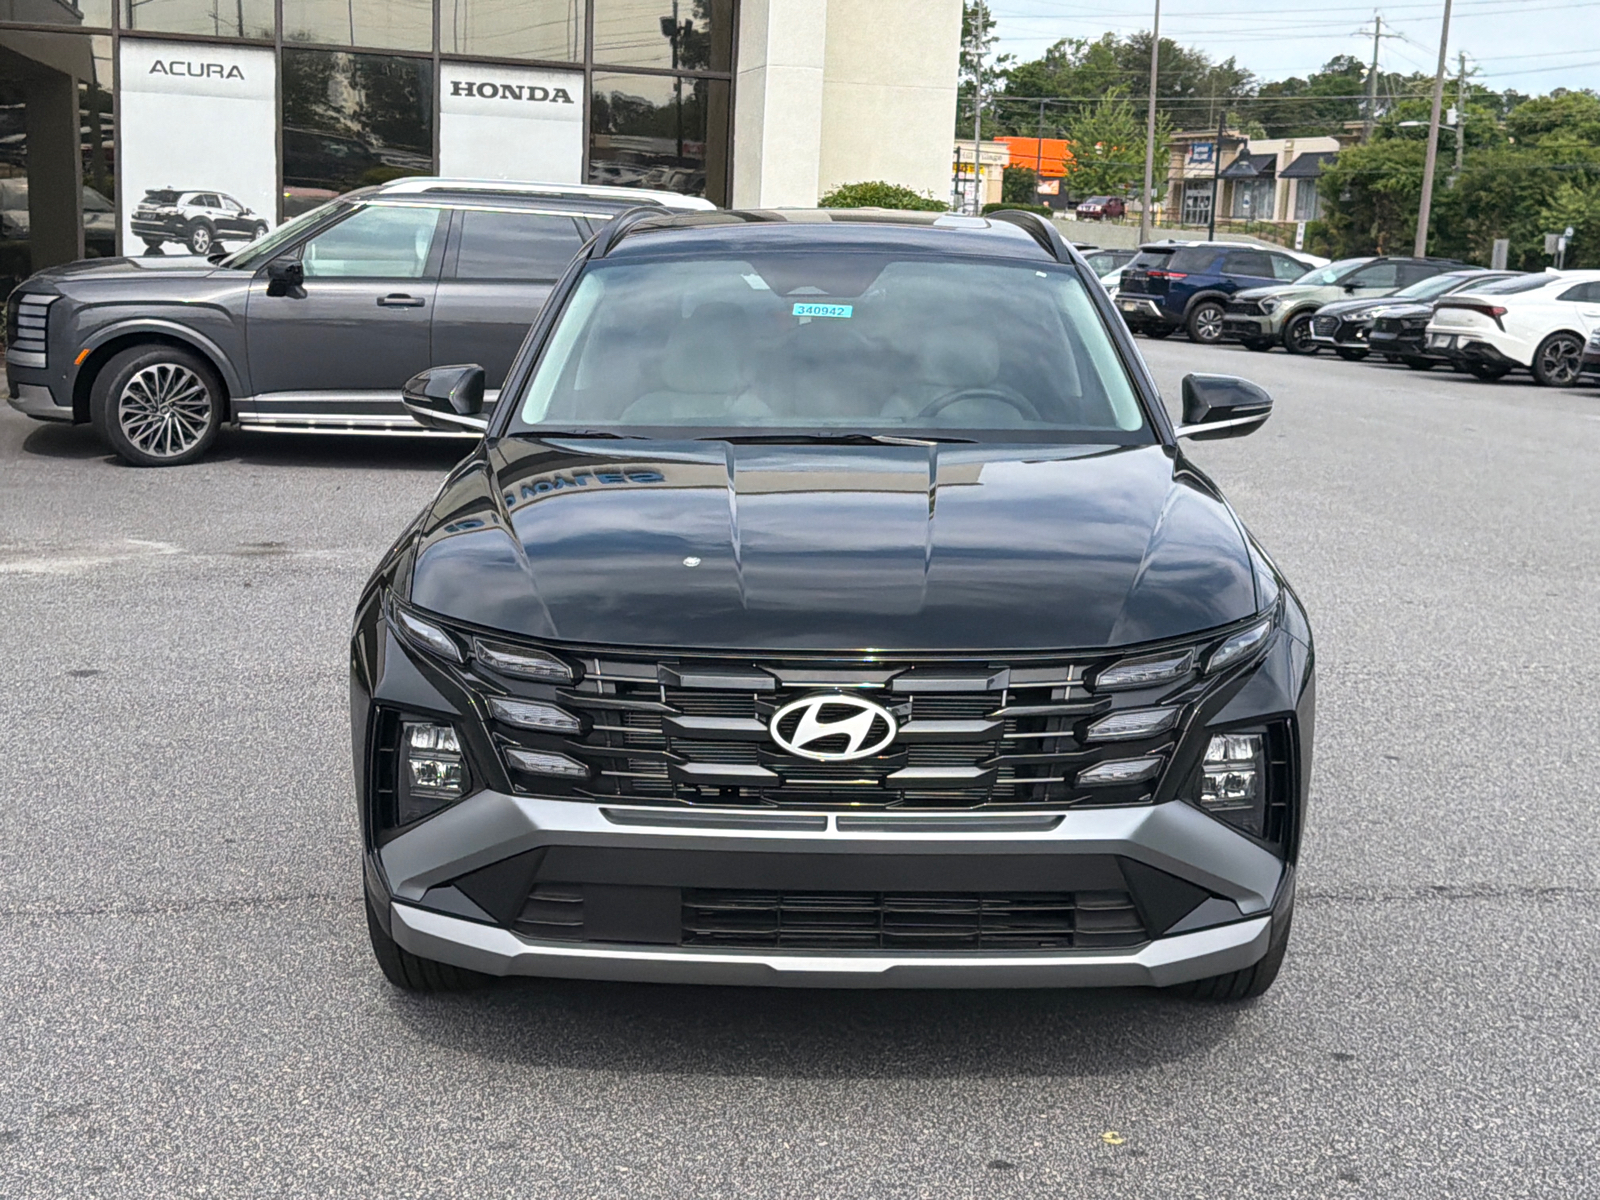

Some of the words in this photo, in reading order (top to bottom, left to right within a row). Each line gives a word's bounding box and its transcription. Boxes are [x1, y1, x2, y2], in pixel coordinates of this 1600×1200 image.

[148, 59, 245, 81] ACURA
[450, 80, 575, 104] HONDA
[797, 305, 845, 316] 340942
